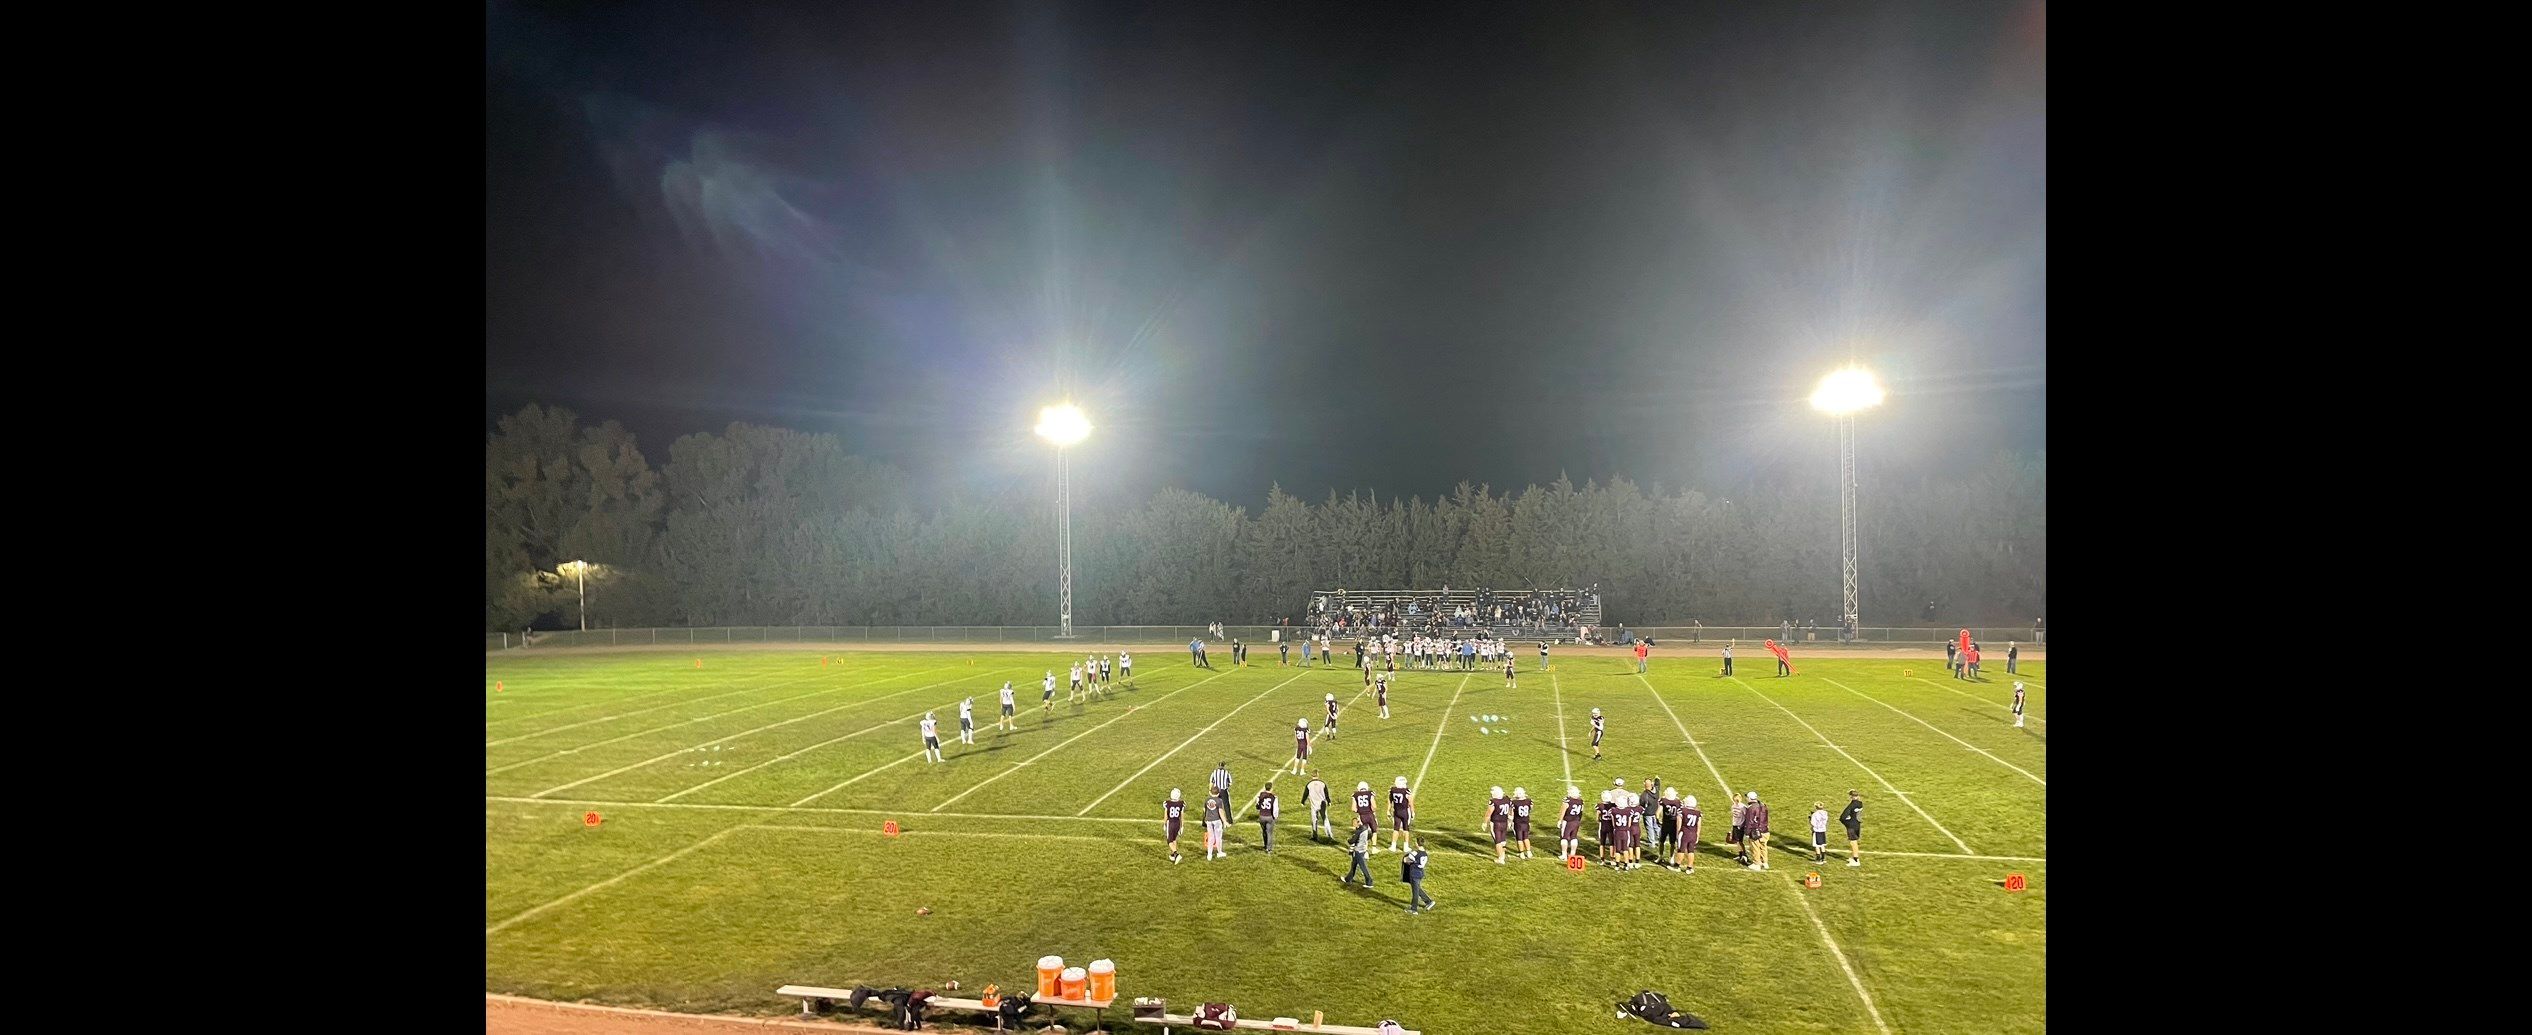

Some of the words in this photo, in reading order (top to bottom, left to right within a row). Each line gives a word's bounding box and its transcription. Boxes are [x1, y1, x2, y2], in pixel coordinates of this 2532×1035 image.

[1357, 795, 1369, 808] 65
[1393, 793, 1404, 804] 57
[1169, 806, 1181, 818] 86
[1499, 804, 1509, 816] 70
[1518, 805, 1529, 817] 68
[1569, 804, 1581, 816] 24
[1665, 805, 1677, 817] 30
[586, 814, 596, 824] 20
[1615, 814, 1627, 827] 34
[1569, 856, 1583, 870] 30
[2012, 876, 2024, 890] 20
